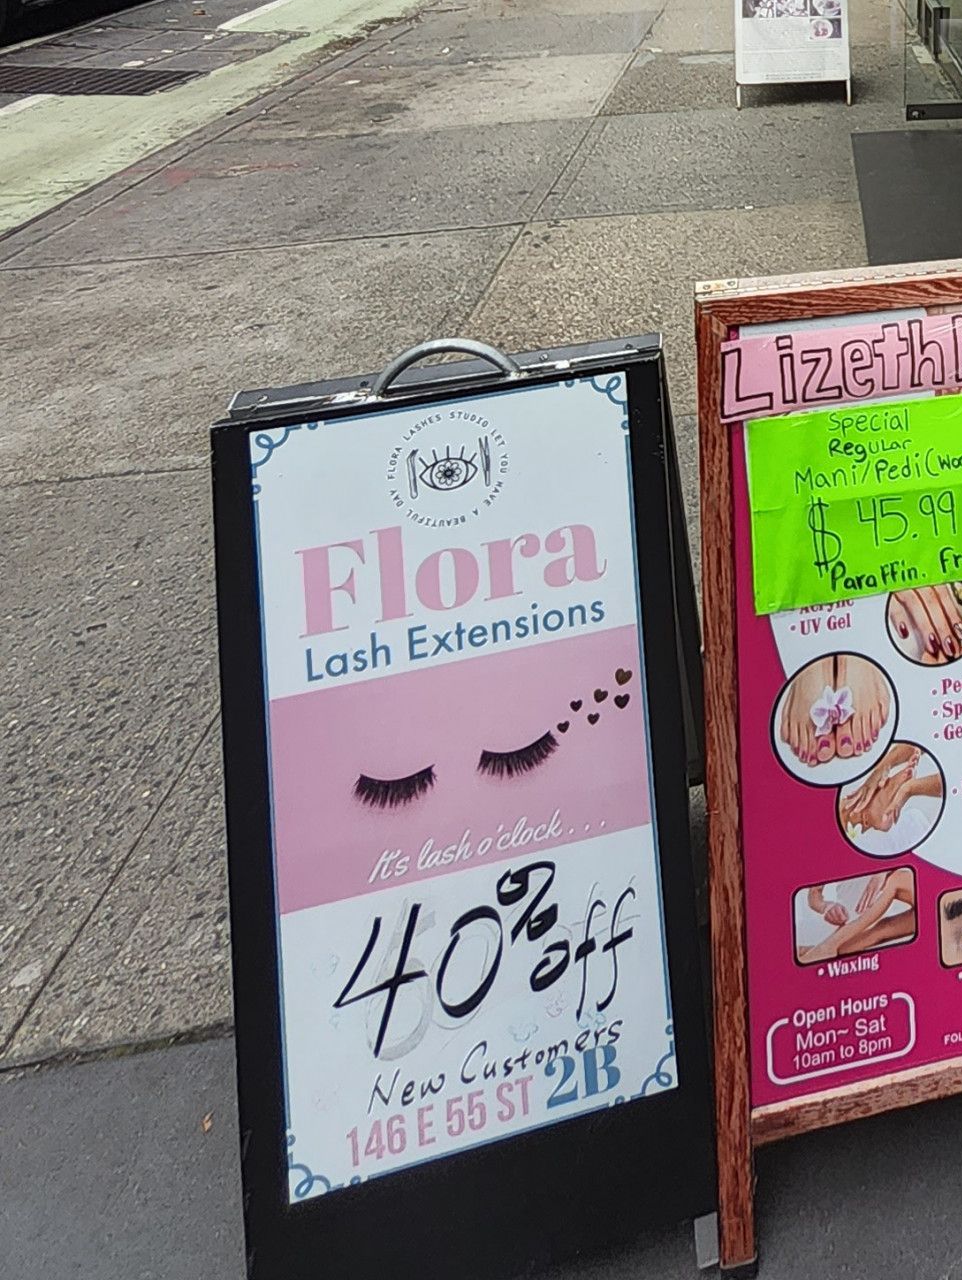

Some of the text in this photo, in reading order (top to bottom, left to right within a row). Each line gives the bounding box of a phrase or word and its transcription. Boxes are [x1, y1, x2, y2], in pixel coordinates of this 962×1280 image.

[721, 320, 945, 419] Lizeth
[387, 411, 489, 481] FLORA LASHES STUDIO
[490, 429, 507, 447] LET
[499, 453, 509, 474] YOU
[389, 489, 405, 508] DAY
[482, 481, 504, 507] HAVE
[405, 508, 466, 528] BEAUTIFUL
[858, 490, 957, 548] 45.99
[294, 522, 607, 640] Flora
[305, 599, 607, 684] Lash Extensions
[800, 612, 851, 636] UV Gel
[367, 849, 411, 885] It's
[416, 833, 474, 870] lash
[530, 886, 637, 1022] off
[826, 954, 880, 980] Waxing
[793, 992, 889, 1030] Open Hours
[854, 1014, 887, 1036] Sat
[367, 1018, 624, 1116] New Customers
[792, 1034, 892, 1072] 10am to 8pm
[346, 1044, 622, 1168] 146 E 55 ST 2B
